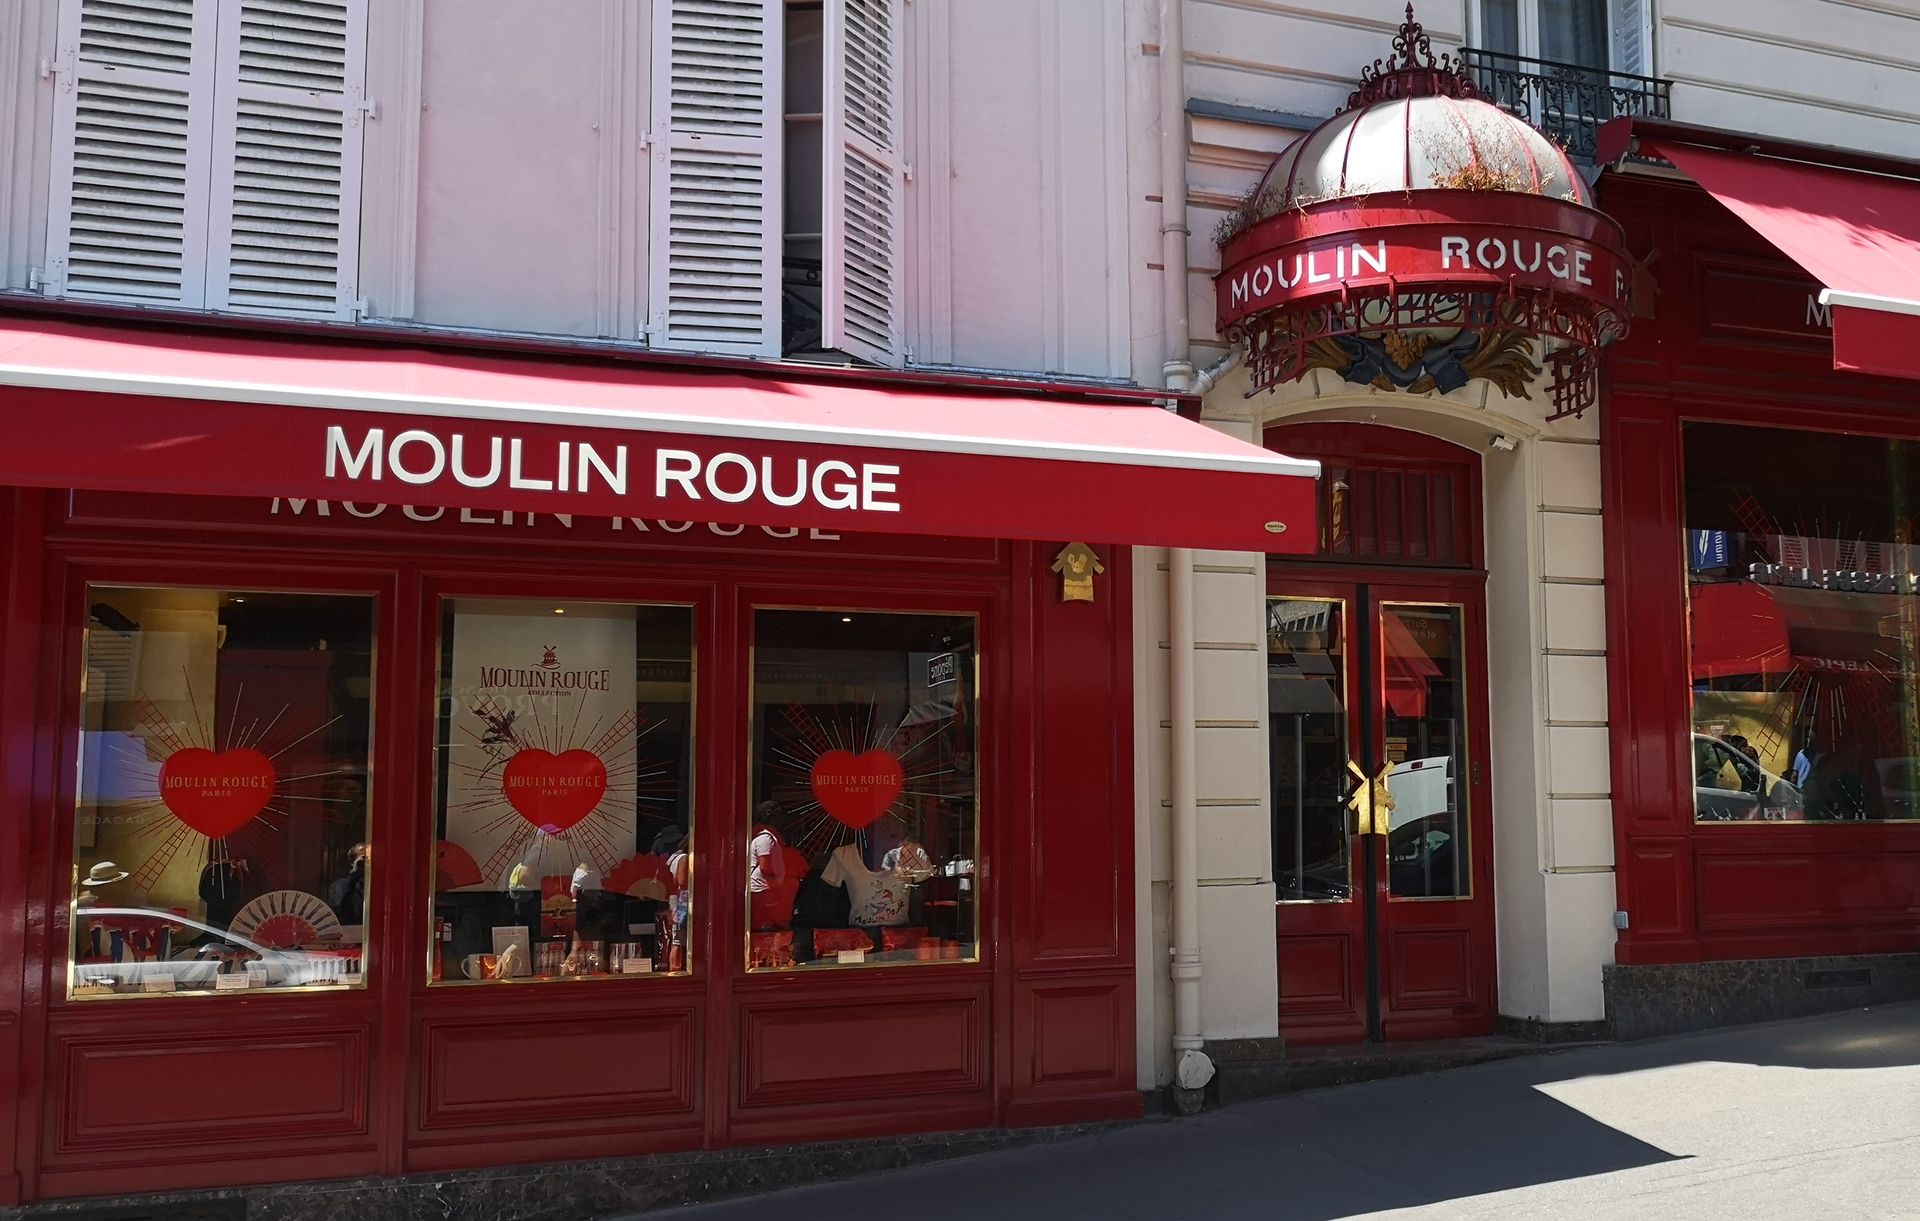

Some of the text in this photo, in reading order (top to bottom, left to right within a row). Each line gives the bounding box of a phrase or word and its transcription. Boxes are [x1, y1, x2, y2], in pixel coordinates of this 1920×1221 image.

[1231, 239, 1387, 310] MOULIN
[1441, 236, 1592, 286] ROUGE
[325, 426, 900, 512] MOULIN ROUGE
[480, 666, 610, 691] MOULIN ROUGE
[528, 689, 571, 697] COLLECTION
[165, 775, 268, 789] MOULIN ROUGE
[509, 775, 600, 788] MOULIN ROUGE
[816, 774, 897, 786] MOULIN ROUGE
